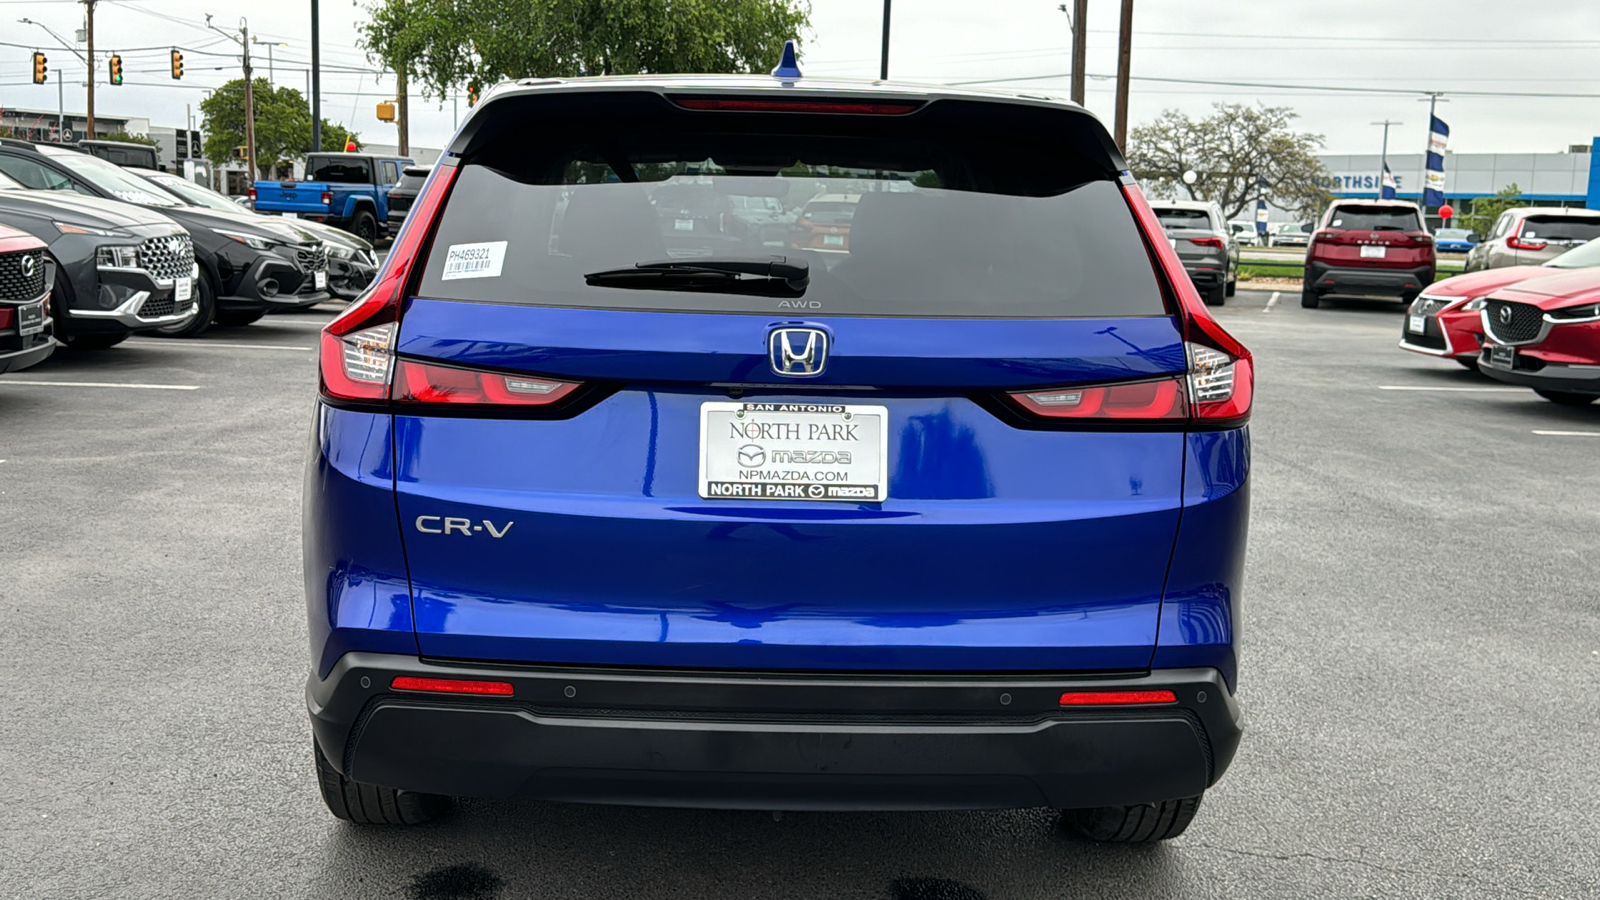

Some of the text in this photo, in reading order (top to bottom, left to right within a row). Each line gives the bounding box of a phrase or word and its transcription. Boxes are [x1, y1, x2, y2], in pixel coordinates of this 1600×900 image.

[449, 248, 490, 262] PH469321
[778, 300, 822, 309] AWD
[779, 404, 843, 413] ANTONIO
[729, 422, 860, 441] NORTH PARK
[771, 450, 852, 464] mazda
[739, 470, 848, 481] NPMAZDA.COM
[711, 483, 875, 497] NORTH PARK mazda
[415, 515, 514, 538] CR-V
